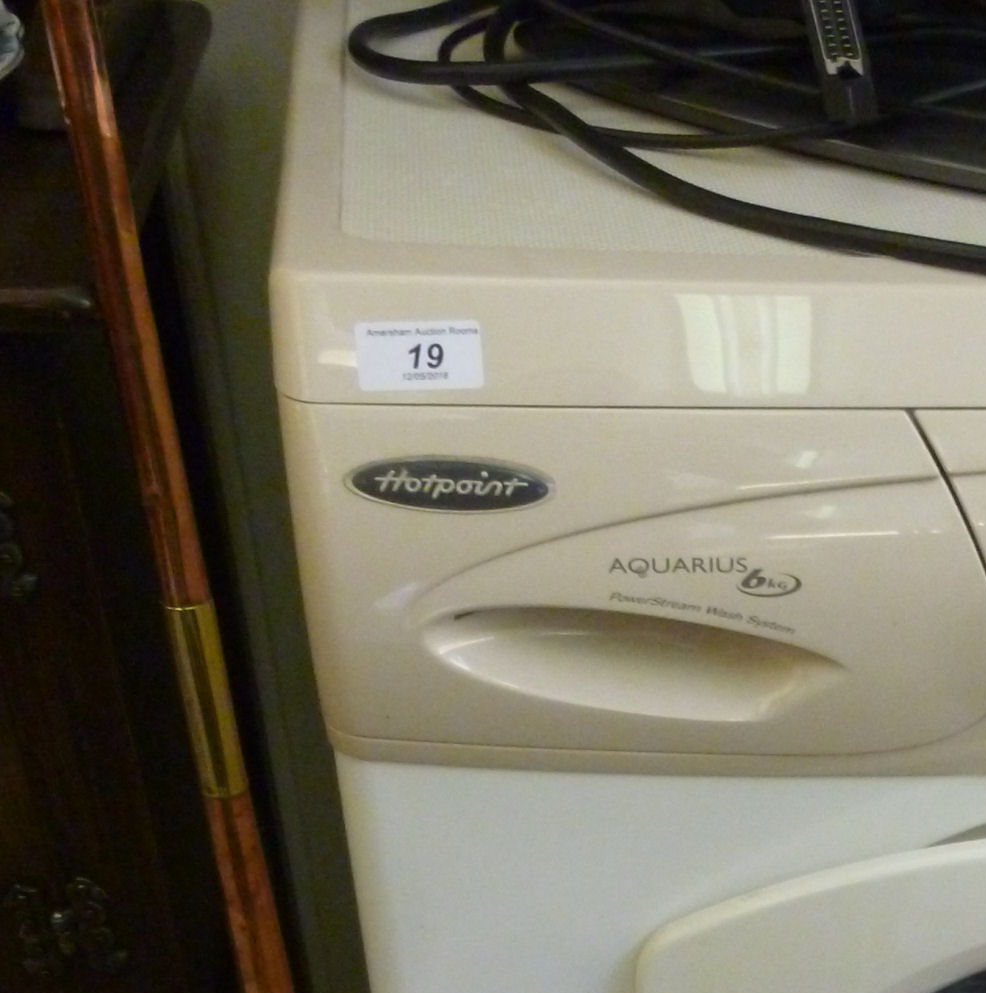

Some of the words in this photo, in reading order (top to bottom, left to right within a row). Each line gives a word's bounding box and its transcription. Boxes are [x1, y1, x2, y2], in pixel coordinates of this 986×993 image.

[366, 328, 412, 337] Amersham
[415, 327, 446, 336] Auction
[449, 326, 479, 335] Rooms
[408, 343, 445, 369] 19
[374, 469, 529, 498] Hotpoint
[608, 556, 748, 578] AQUARIUS
[609, 591, 703, 612] PowerStream
[705, 606, 744, 621] Wash
[746, 615, 797, 635] System
